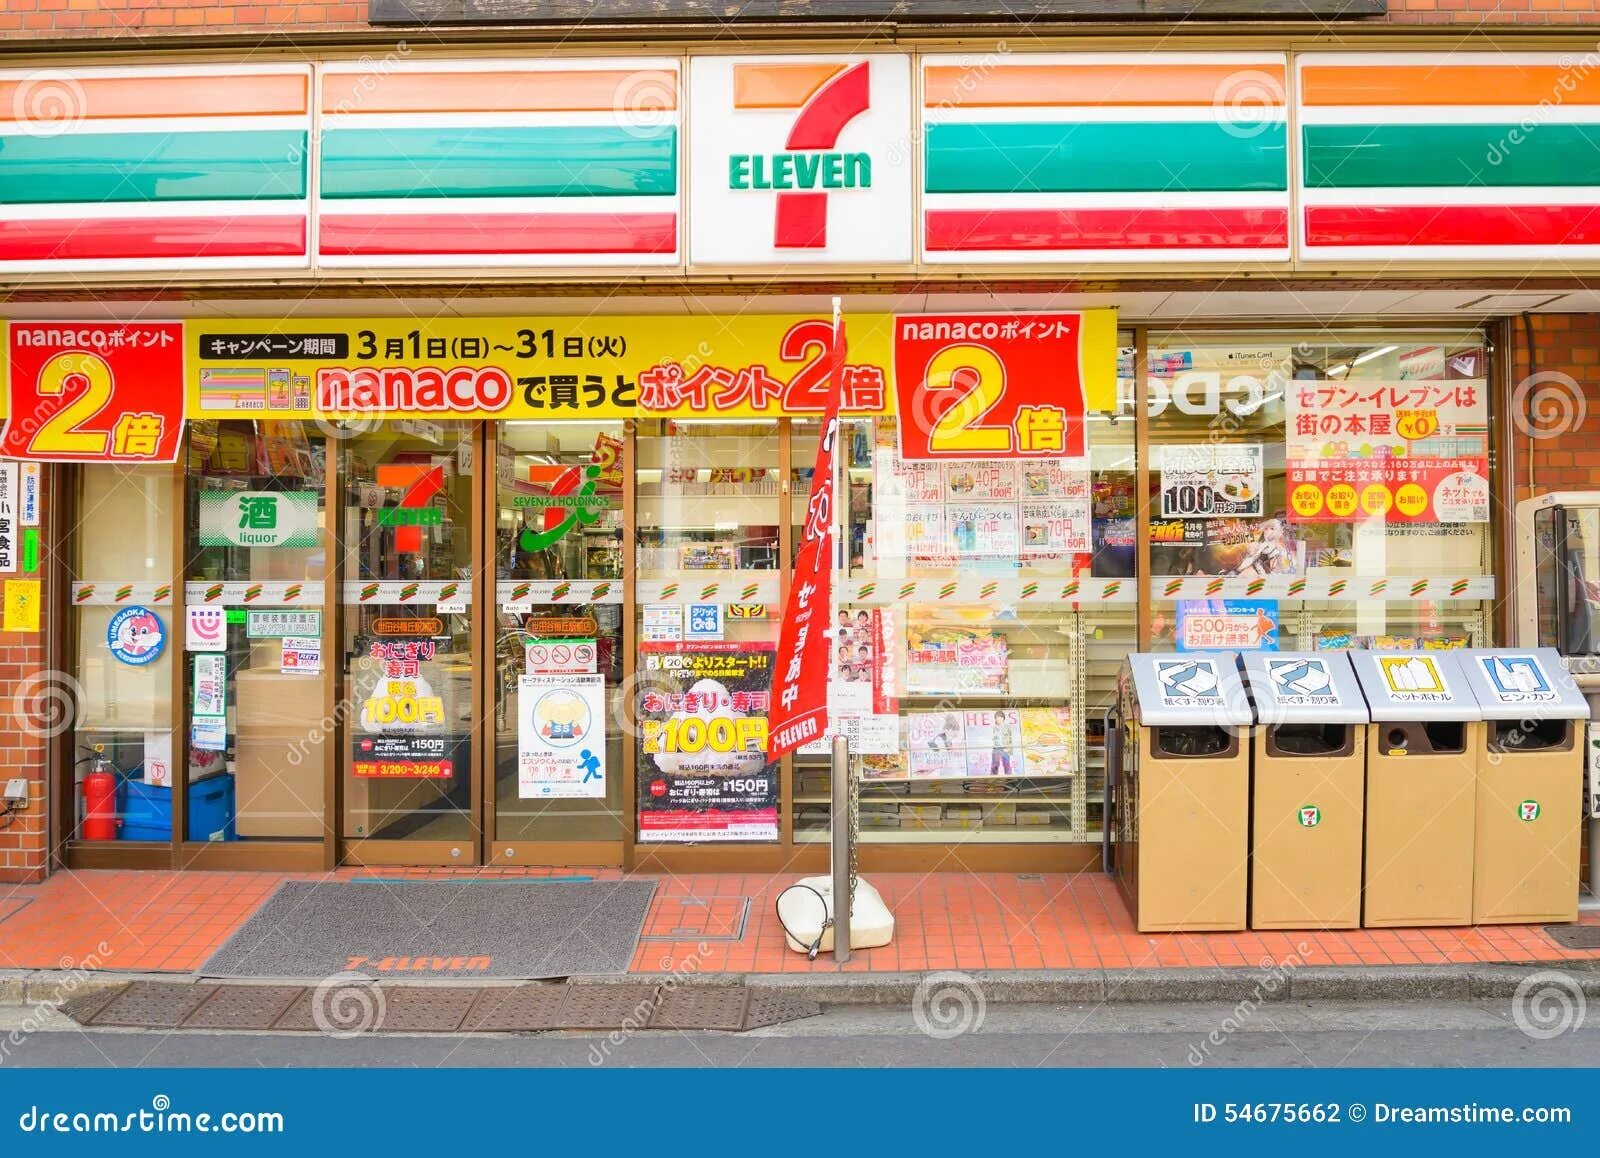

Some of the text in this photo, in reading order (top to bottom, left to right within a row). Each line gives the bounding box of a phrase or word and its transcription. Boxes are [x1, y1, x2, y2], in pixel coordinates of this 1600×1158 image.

[729, 151, 872, 190] ELEVEN
[210, 338, 336, 356] キャンペーン期間
[1296, 386, 1477, 408] セブン-イレブンは
[1296, 414, 1391, 435] 街の本屋
[238, 496, 278, 529] 酒
[239, 532, 278, 545] liquor
[369, 641, 436, 661] おにぎり
[385, 660, 420, 679] 寿司
[362, 696, 446, 725] 100円
[660, 716, 769, 754] 100円
[729, 779, 769, 792] 150円
[345, 955, 491, 972] 7-ELEVEN
